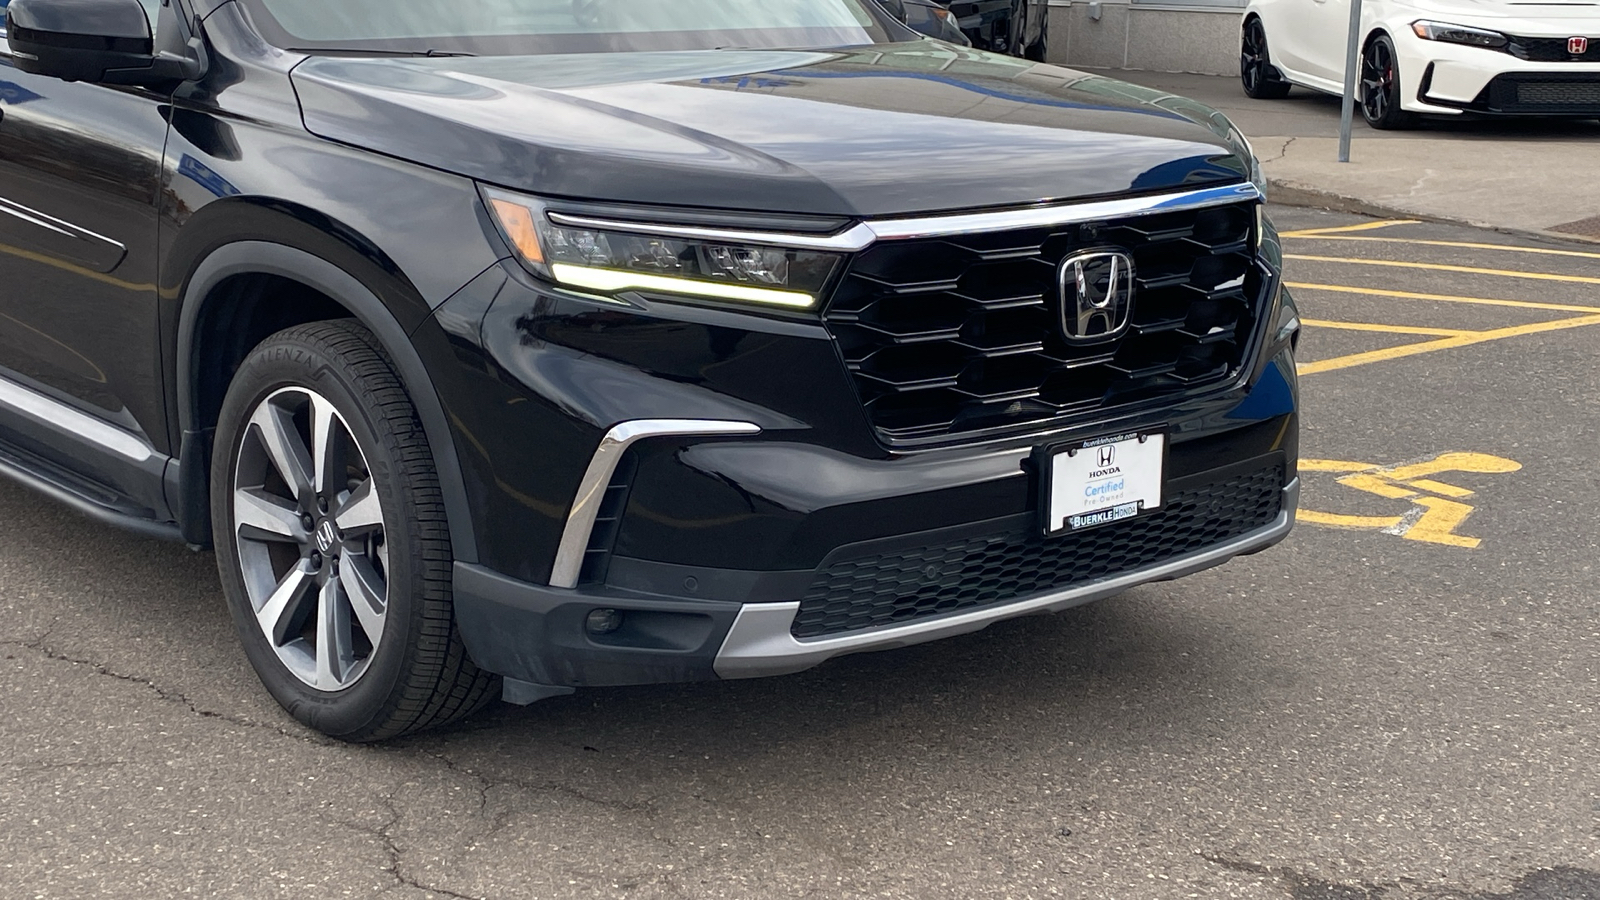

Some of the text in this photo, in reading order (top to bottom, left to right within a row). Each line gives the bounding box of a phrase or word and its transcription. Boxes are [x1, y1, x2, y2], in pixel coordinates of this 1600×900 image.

[260, 347, 313, 369] ALENZA
[1088, 466, 1121, 478] HONDA
[1085, 479, 1124, 497] Certified
[1073, 506, 1136, 527] BUERKLE HONDA
